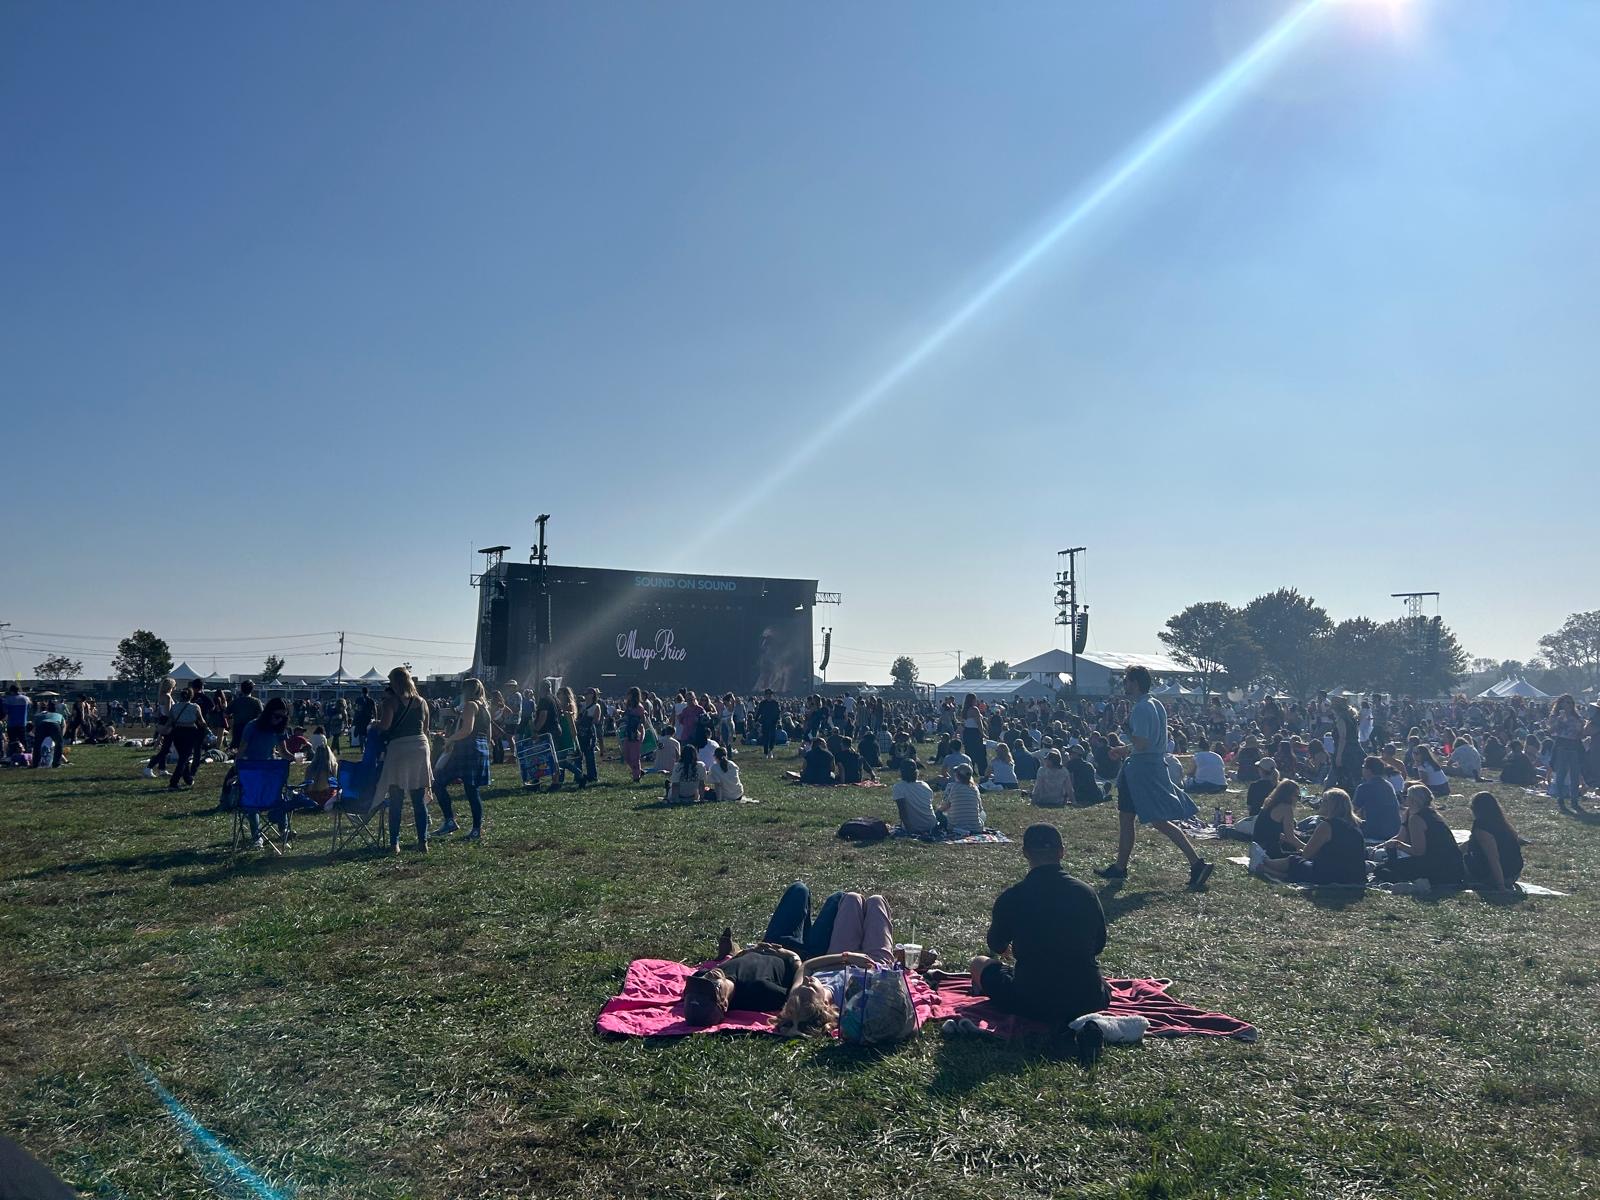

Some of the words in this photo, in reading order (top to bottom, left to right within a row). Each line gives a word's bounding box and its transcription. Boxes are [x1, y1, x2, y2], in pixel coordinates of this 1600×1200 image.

[635, 576, 675, 588] SOUND
[678, 579, 695, 589] ON
[698, 580, 737, 591] SOUND
[616, 629, 657, 670] Margo
[655, 628, 687, 661] Price
